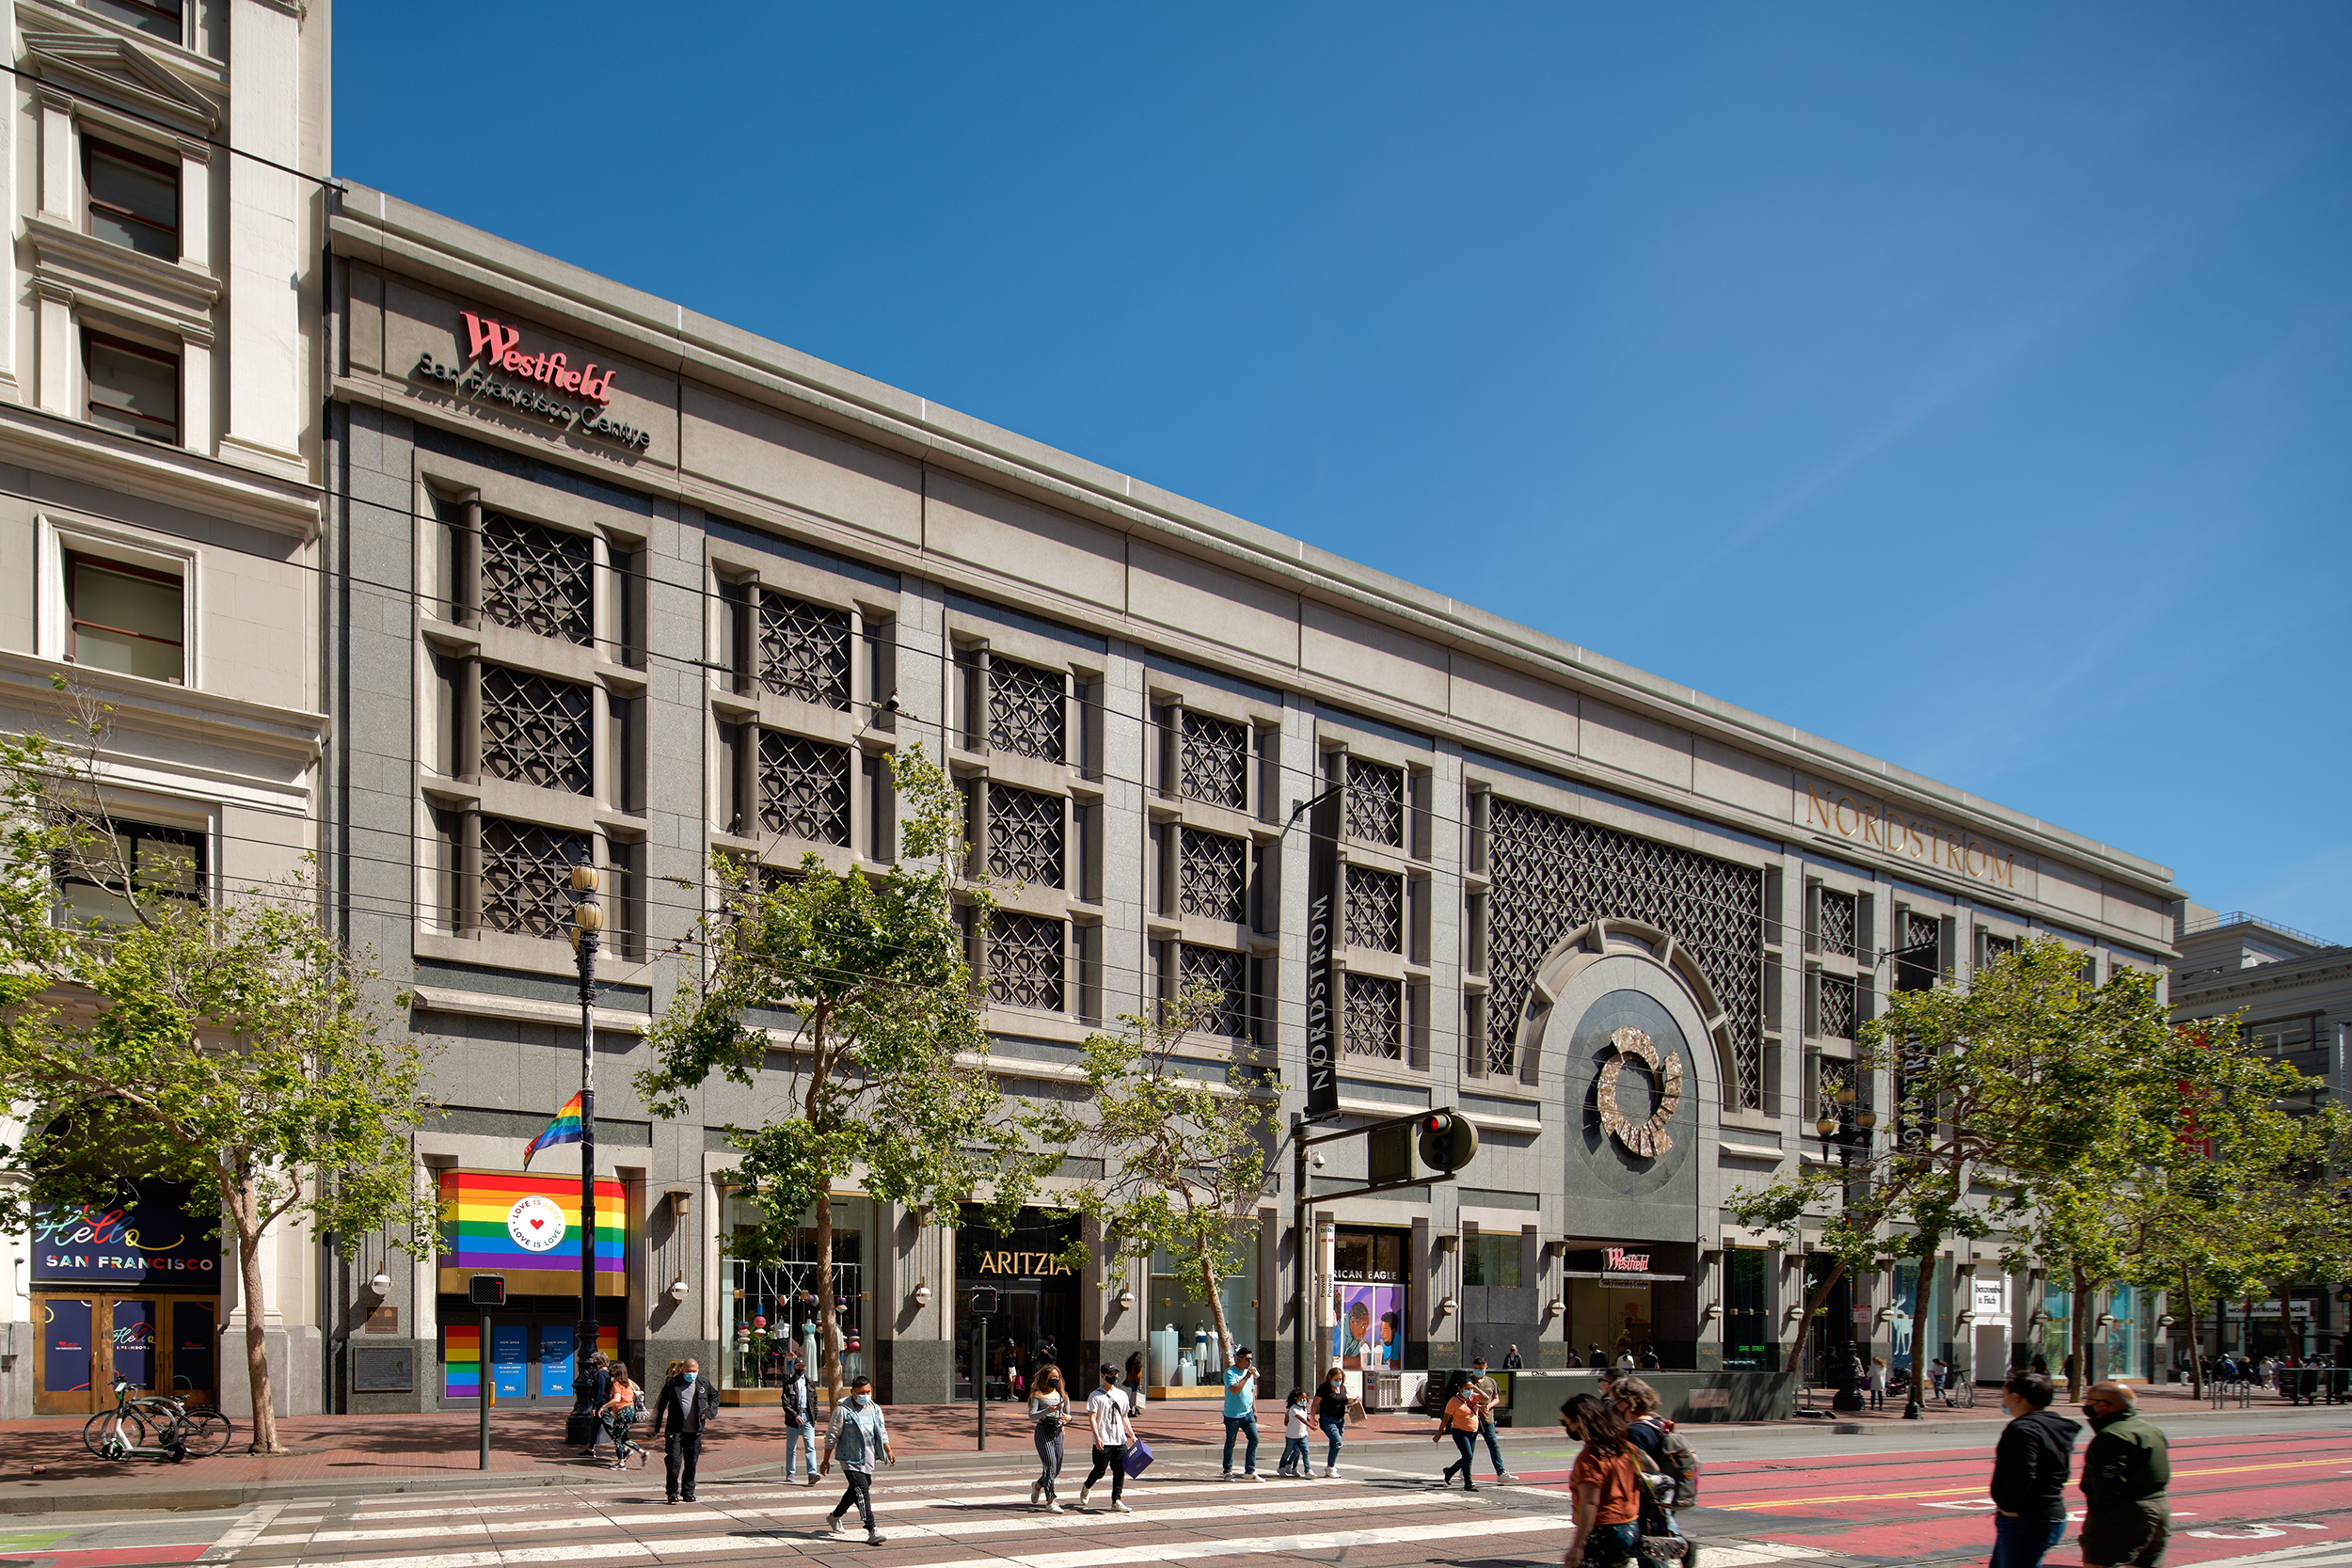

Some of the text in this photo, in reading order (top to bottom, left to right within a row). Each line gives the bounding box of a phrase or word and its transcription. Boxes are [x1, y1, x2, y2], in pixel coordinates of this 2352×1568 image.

[459, 311, 616, 406] Westfield
[420, 351, 651, 448] San Francisco Centre
[1806, 783, 2014, 889] NORDSTROM
[1309, 894, 1329, 1091] NORDSTROM
[512, 1200, 531, 1219] LOVE
[544, 1201, 562, 1221] LOVE
[35, 1204, 184, 1251] Hello
[513, 1227, 531, 1246] LOVE
[544, 1228, 562, 1246] LOVE
[45, 1254, 214, 1271] SAN FRANCISCO
[979, 1250, 1072, 1275] ARITZIA
[1602, 1247, 1650, 1271] Westfield
[1332, 1269, 1397, 1280] RICAN EAGLE
[113, 1322, 156, 1343] Hello
